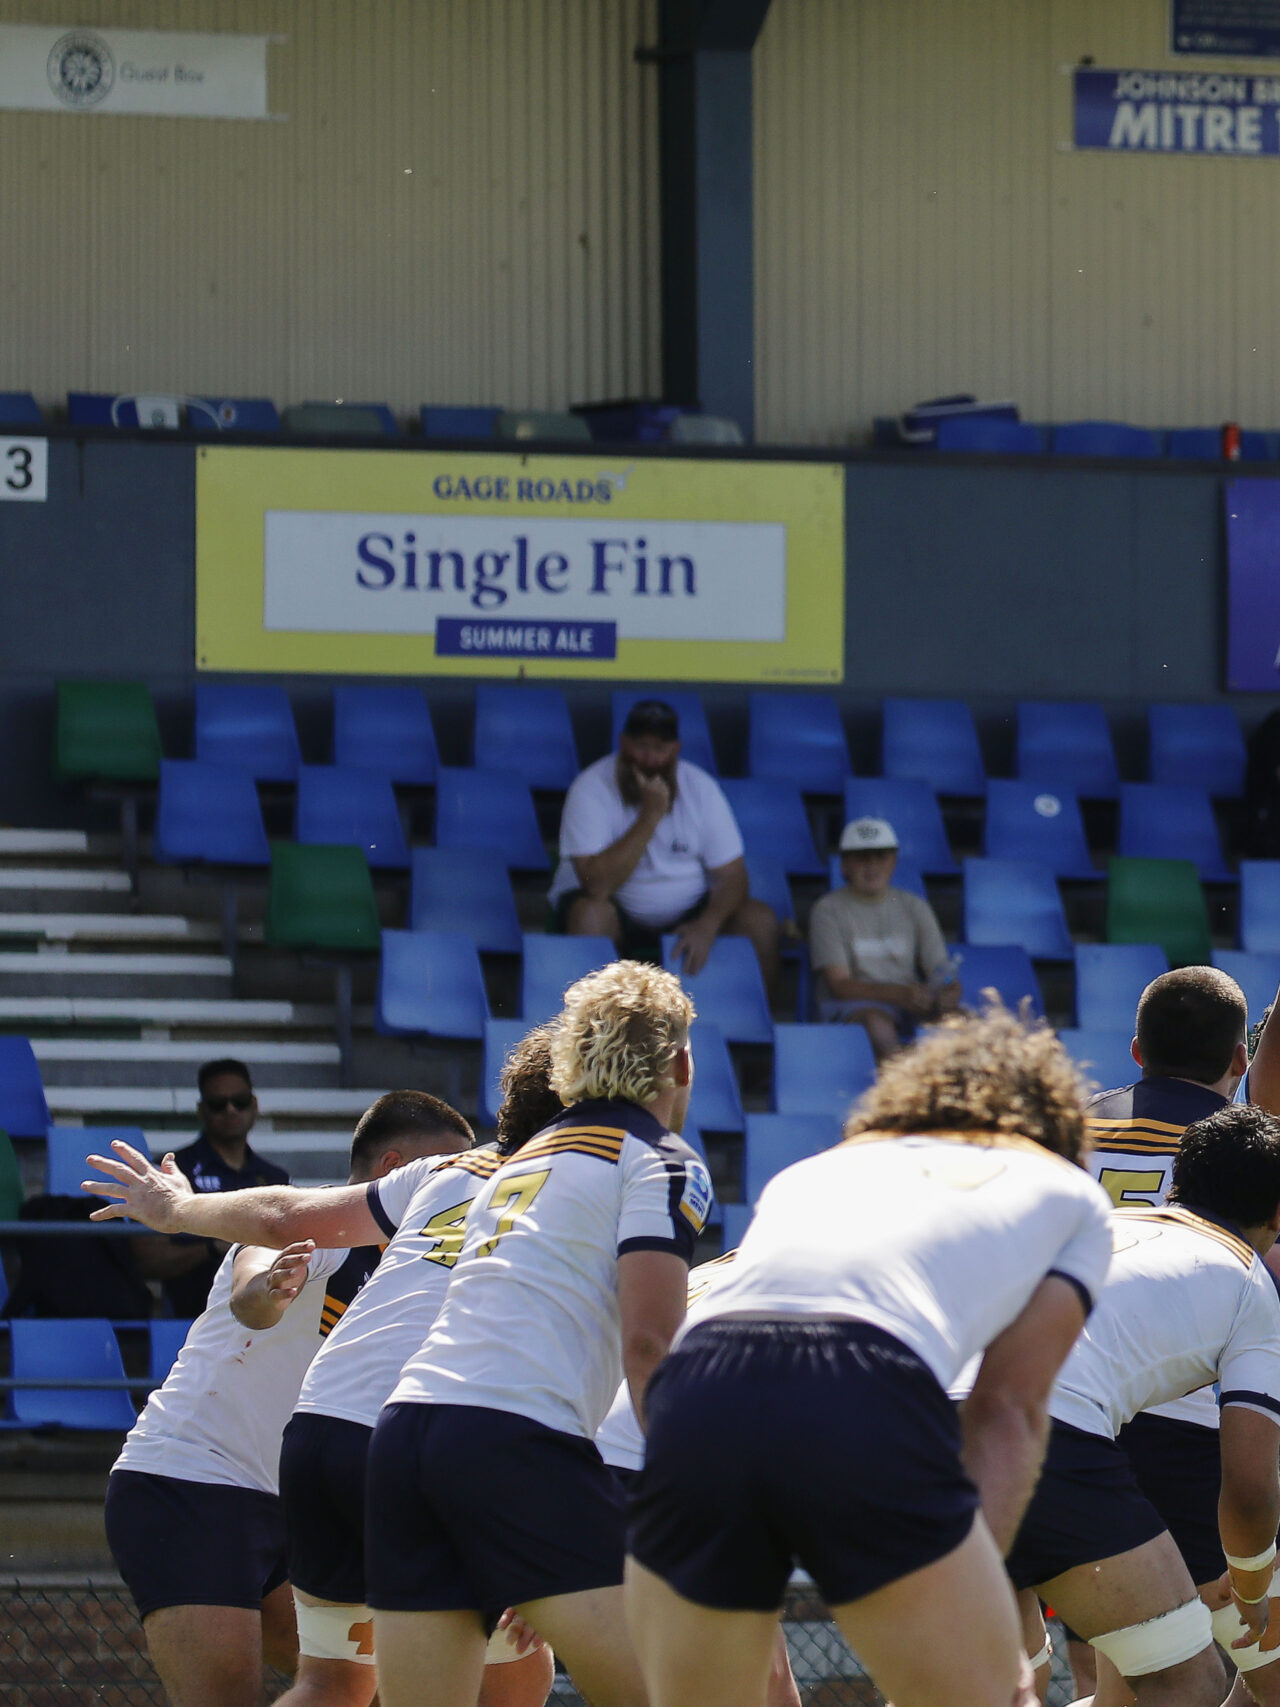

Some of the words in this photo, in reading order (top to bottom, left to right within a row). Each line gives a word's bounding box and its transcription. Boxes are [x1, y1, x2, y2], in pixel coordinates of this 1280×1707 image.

[1115, 73, 1246, 101] JOHNSON
[1109, 101, 1262, 151] MITRE
[6, 447, 33, 490] 3
[433, 475, 510, 500] GAGE
[516, 477, 612, 504] ROADS
[355, 531, 569, 611] Single
[589, 538, 696, 596] Fin
[460, 626, 549, 650] SUMMER
[556, 628, 593, 652] ALE
[419, 1196, 477, 1269] 4
[476, 1168, 552, 1258] 7
